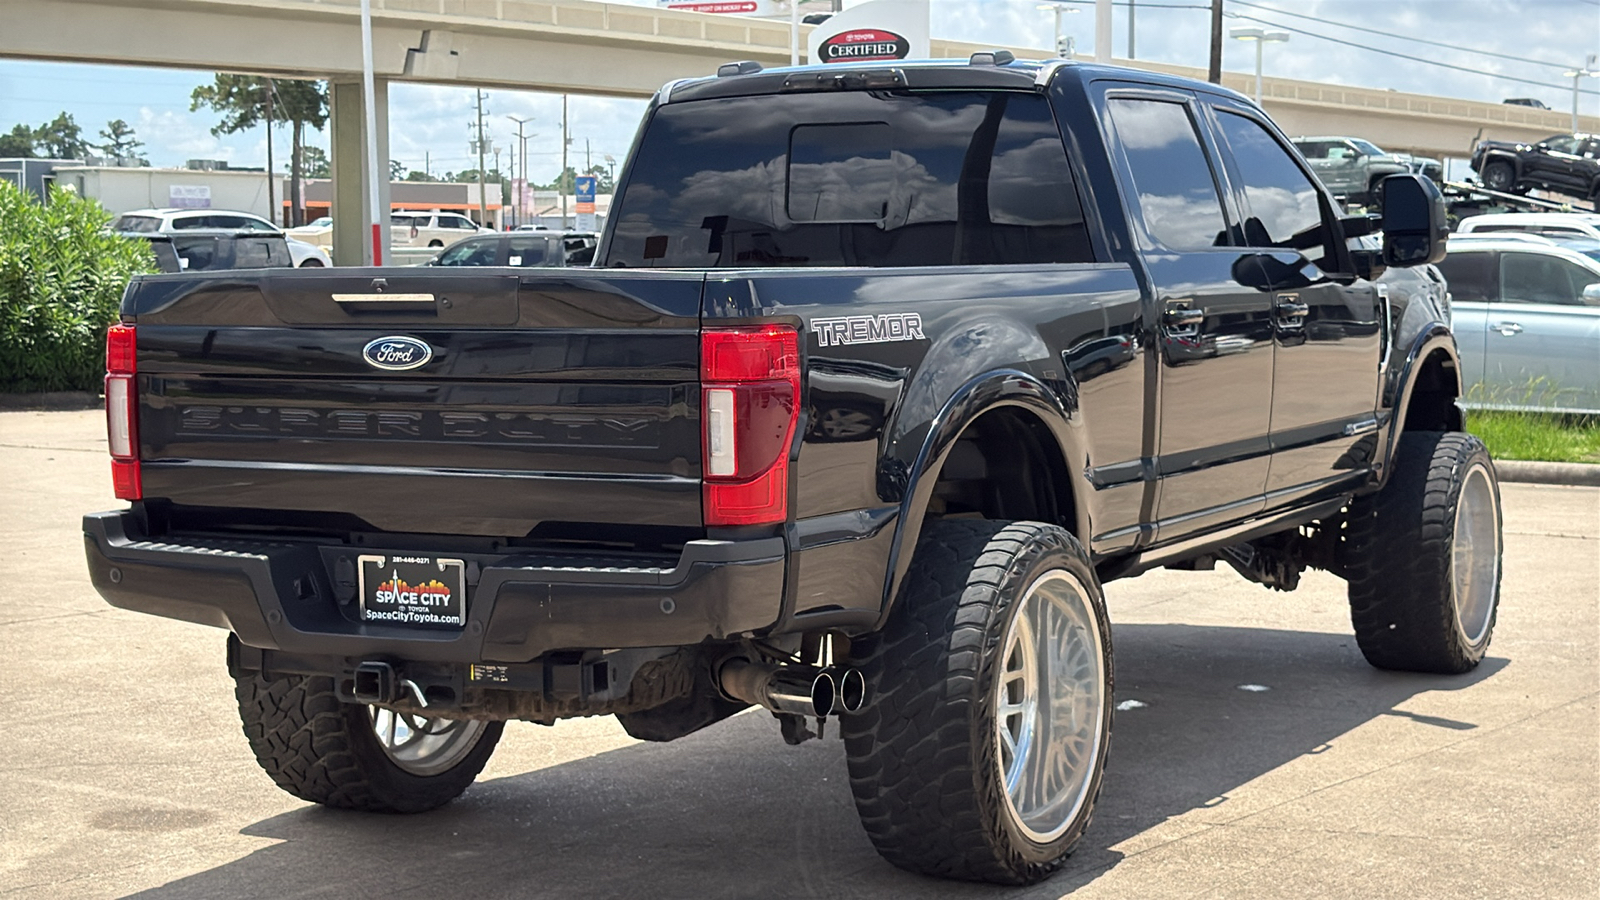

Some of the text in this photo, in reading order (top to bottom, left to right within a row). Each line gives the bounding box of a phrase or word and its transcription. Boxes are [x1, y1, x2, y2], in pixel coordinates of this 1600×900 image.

[828, 43, 897, 57] CERTIFIED
[810, 312, 925, 347] TREMOR
[377, 343, 414, 362] Ford
[376, 590, 451, 606] SPACE CITY
[366, 609, 460, 624] SpaceCityToyota.com
[408, 605, 430, 613] TOYOTA
